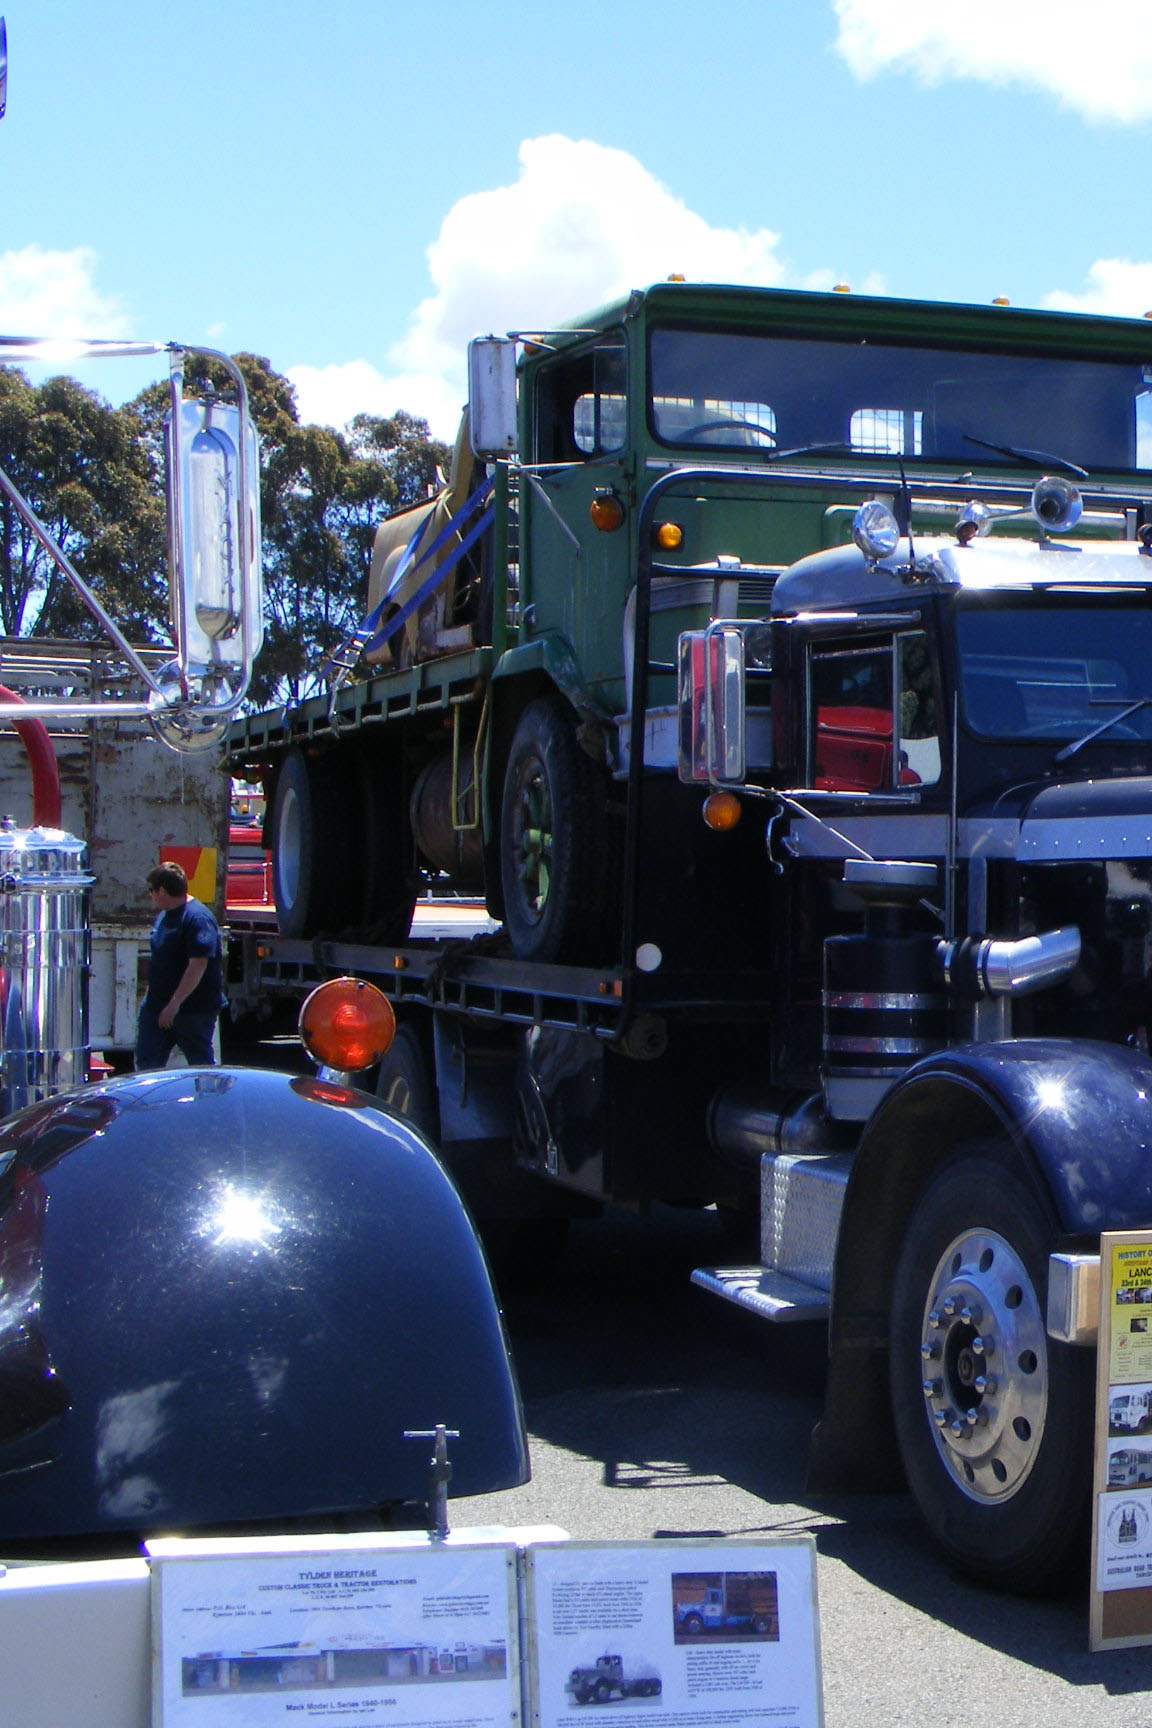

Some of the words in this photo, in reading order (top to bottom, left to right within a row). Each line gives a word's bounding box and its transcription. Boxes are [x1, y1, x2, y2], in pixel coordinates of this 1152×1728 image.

[1118, 1250, 1146, 1259] HISTORY
[298, 1572, 332, 1580] TYLDEN
[334, 1570, 378, 1579] HERITAGE
[285, 1582, 311, 1590] CLASSIC
[341, 1580, 370, 1588] TRACTOR
[286, 1704, 304, 1712] Mack
[306, 1702, 328, 1710] Model
